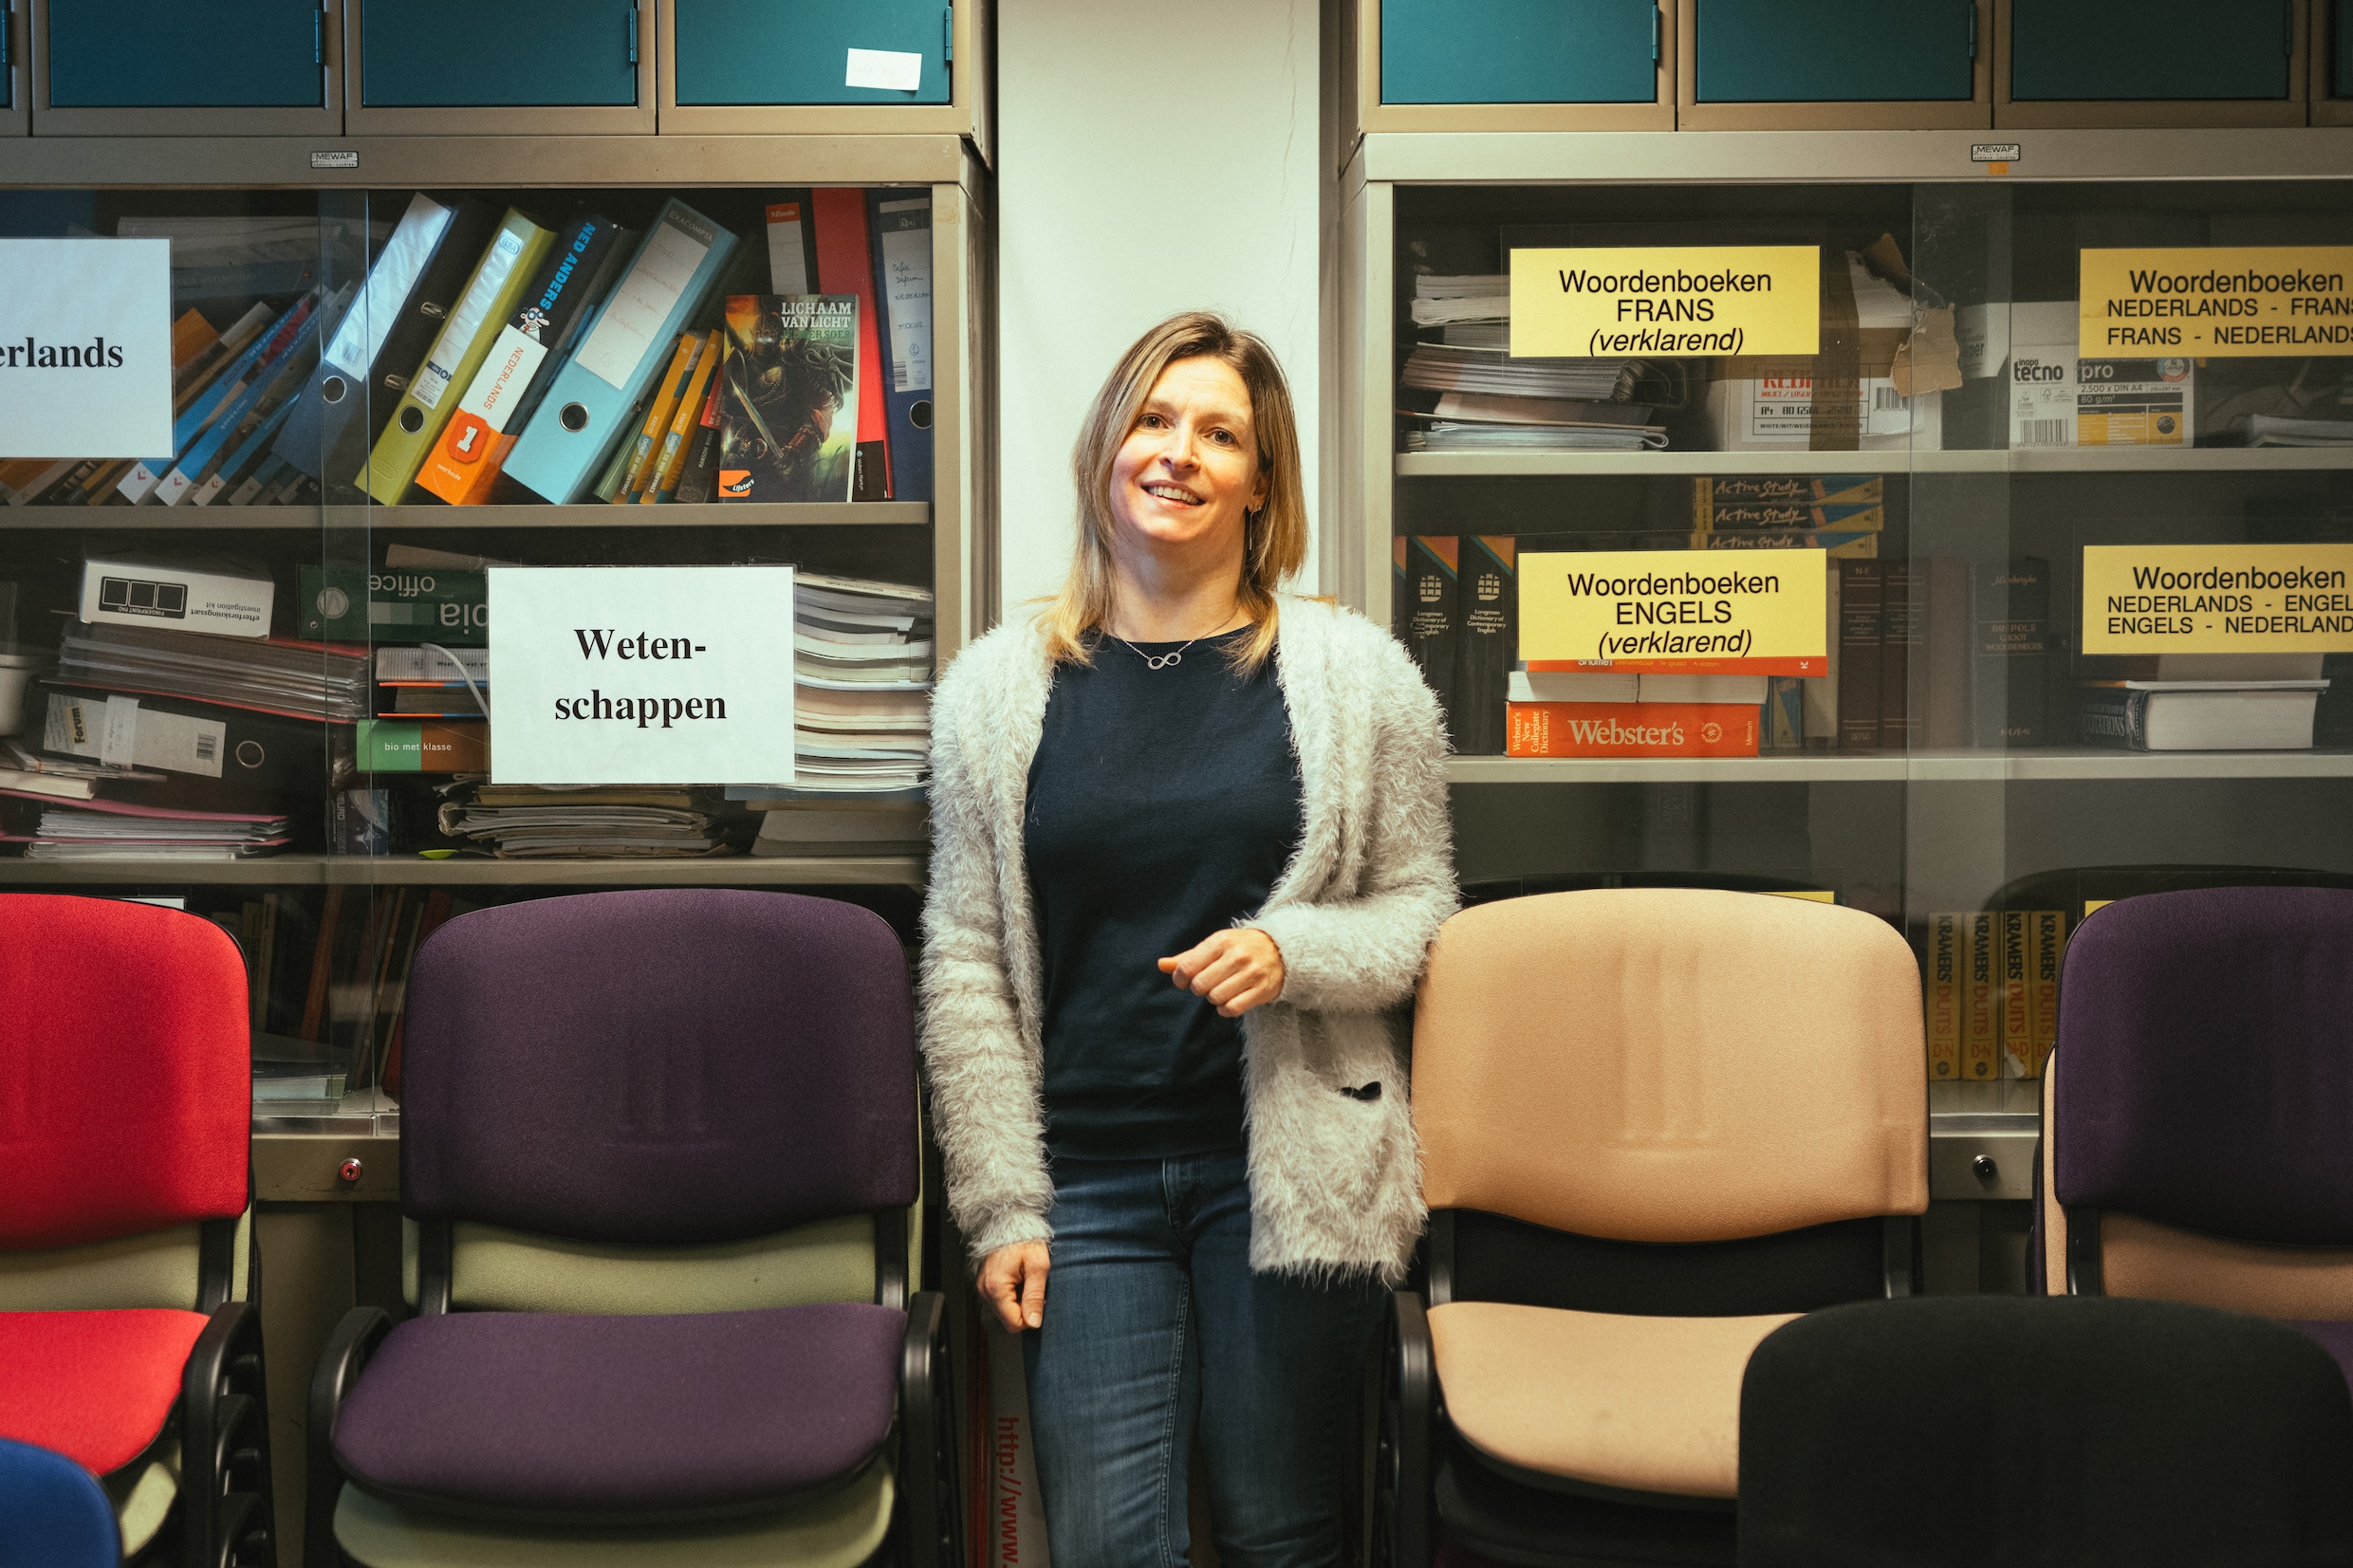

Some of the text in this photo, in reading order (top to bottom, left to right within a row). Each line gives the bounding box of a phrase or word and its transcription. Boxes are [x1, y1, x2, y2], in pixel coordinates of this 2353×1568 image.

[668, 210, 713, 242] EXACOMPTA
[500, 237, 517, 252] ELBA
[539, 222, 597, 310] NED ANDERS
[1559, 269, 1771, 293] Woordenboeken
[2129, 269, 2344, 294] Woordenboeken
[781, 302, 852, 315] LICHAAM
[1617, 299, 1714, 323] FRANS
[2107, 299, 2258, 317] NEDERLANDS
[2291, 298, 2353, 315] FRAN
[781, 316, 852, 328] VAN LICHT
[781, 329, 851, 340] JELMER SOES
[1589, 328, 1744, 356] (verklarend)
[2107, 327, 2181, 345] FRANS
[2214, 325, 2353, 344] NEDERLAND
[0, 337, 123, 368] rlands
[483, 346, 524, 410] NEDERLANDS
[2014, 361, 2064, 381] tecno
[2082, 365, 2114, 382] pro
[2081, 395, 2093, 403] 80
[1761, 406, 1773, 415] A4
[648, 415, 658, 434] OLIVER
[676, 413, 687, 431] OLIVER
[456, 426, 478, 452] 1
[698, 446, 709, 469] RANSOM
[436, 463, 462, 482] averbode
[621, 475, 633, 495] EDWARD
[649, 473, 662, 493] EDWARD
[732, 478, 755, 492] Lijsters
[1715, 480, 1760, 494] Active
[1758, 479, 1807, 497] Study
[1715, 508, 1760, 522] Active
[1758, 507, 1808, 526] Study
[1710, 534, 1802, 548] Active Study
[369, 575, 435, 597] office
[1567, 572, 1779, 598] Woordenboeken
[2133, 566, 2345, 589] Woordenboeken
[216, 602, 261, 614] investigation
[1616, 600, 1732, 625] ENGELS
[2108, 596, 2252, 613] NEDERLANDS
[2285, 595, 2353, 612] ENGEL
[191, 609, 261, 622] efterforskningssæt
[1467, 620, 1507, 629] Contemporary
[2108, 618, 2194, 634] ENGELS
[2226, 617, 2353, 633] NEDERLAND
[574, 629, 706, 660] Weten-
[1598, 630, 1752, 659] (verklarend)
[555, 690, 728, 729] schappen
[71, 707, 85, 744] Forum
[1513, 712, 1522, 751] Webster's
[1530, 711, 1539, 752] Collegiate
[1540, 710, 1550, 754] Dictionary
[1567, 718, 1684, 746] Webster's
[384, 742, 452, 751] bio met klasse
[1936, 986, 1952, 1035] DUITS
[1973, 986, 1989, 1035] DUITS
[2008, 984, 2026, 1034] DUITS
[2040, 985, 2056, 1035] DUITS
[1934, 1044, 1955, 1058] D-N
[1971, 1045, 1992, 1058] D-N
